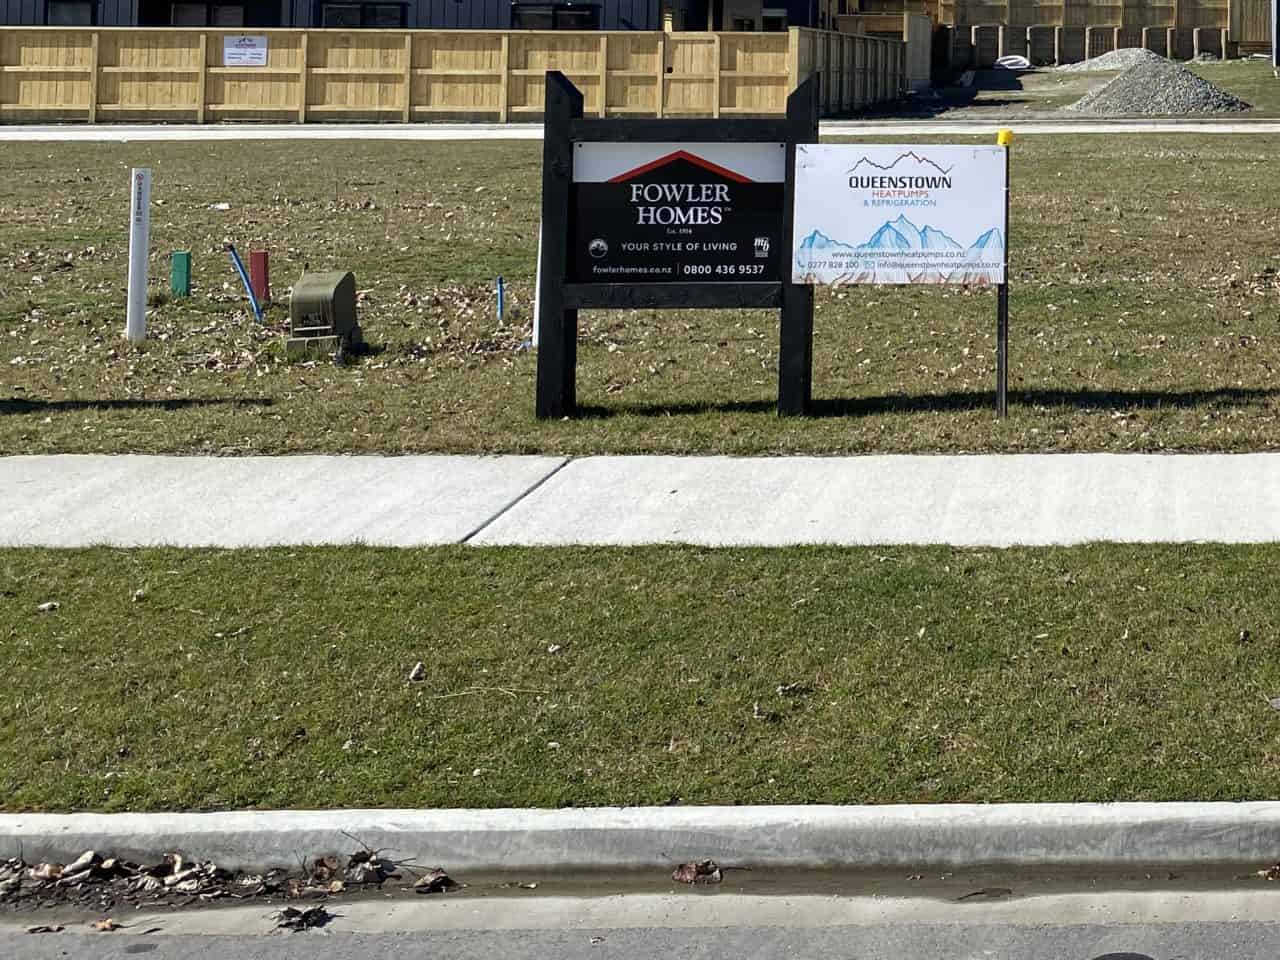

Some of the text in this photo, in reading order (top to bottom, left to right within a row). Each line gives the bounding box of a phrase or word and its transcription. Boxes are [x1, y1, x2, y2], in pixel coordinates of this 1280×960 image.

[849, 175, 952, 189] QUEENSTOWN
[630, 183, 732, 203] FOWLER
[872, 190, 929, 199] HEATPUMPS
[863, 199, 937, 207] & REFRIGERATION
[636, 206, 722, 225] HOMES
[621, 242, 737, 251] YOUR STYLE OF LIVING
[832, 250, 967, 259] www.queenstownheatpumps.co.nz
[592, 265, 672, 274] fowlerhomes.co.nz
[684, 265, 765, 275] 0800 436 9537
